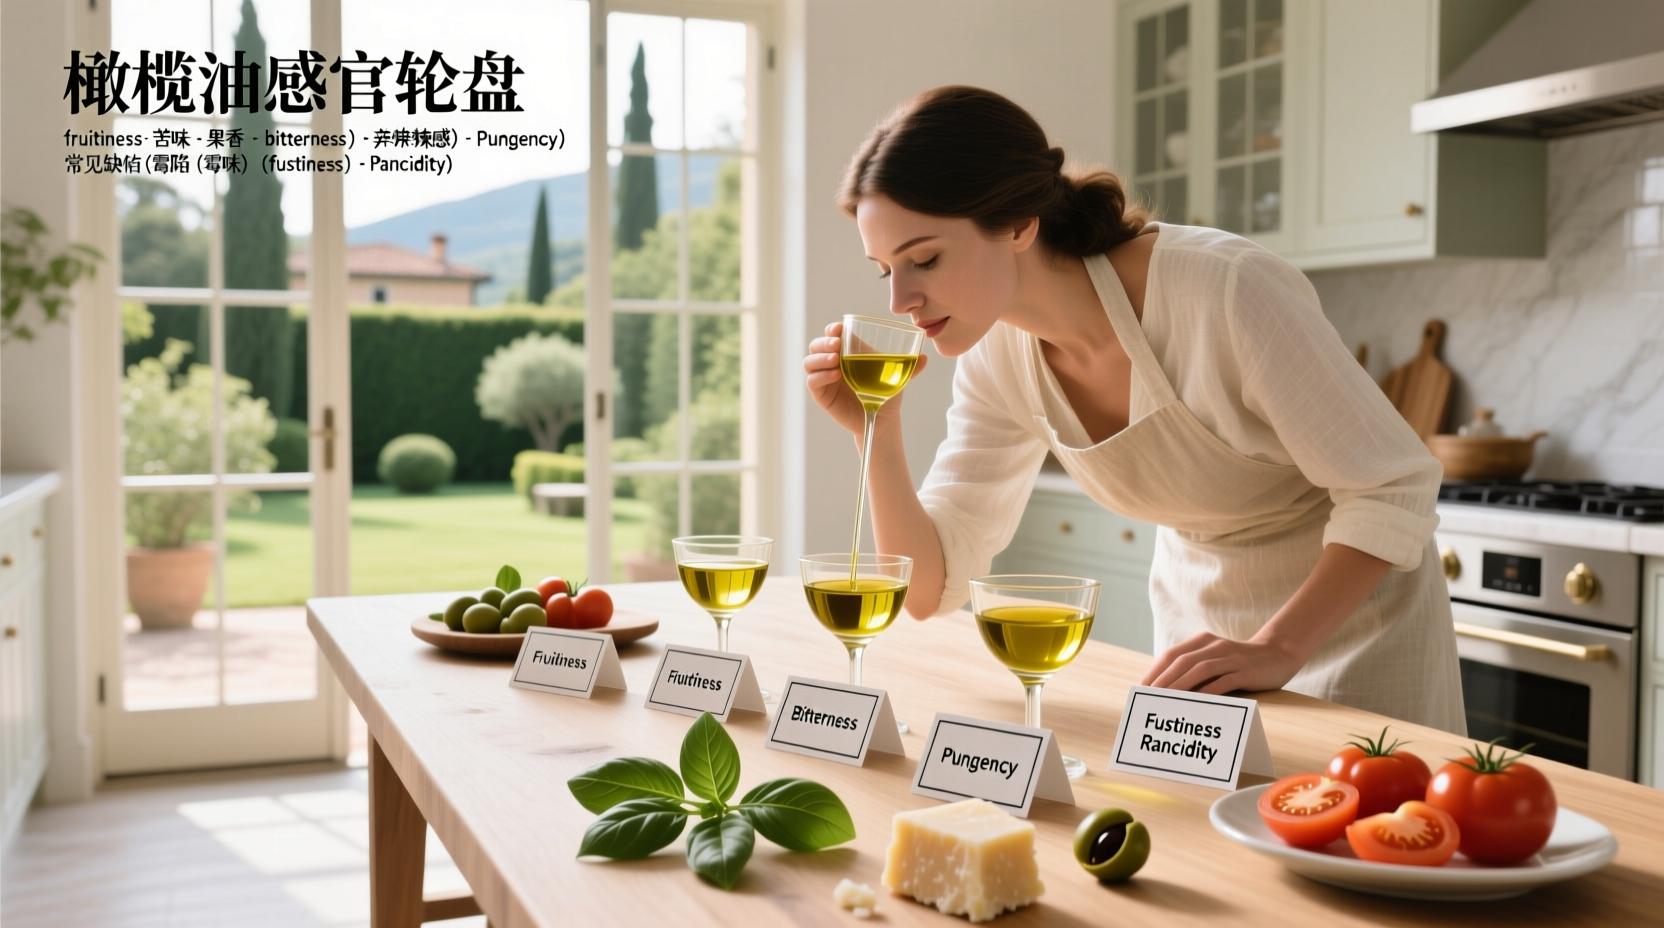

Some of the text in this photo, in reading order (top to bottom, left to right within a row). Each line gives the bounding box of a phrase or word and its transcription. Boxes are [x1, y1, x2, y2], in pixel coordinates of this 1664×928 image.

[1144, 712, 1222, 739] Fustiness
[940, 747, 1019, 780] Pungency
[1140, 733, 1218, 765] Rancidity
